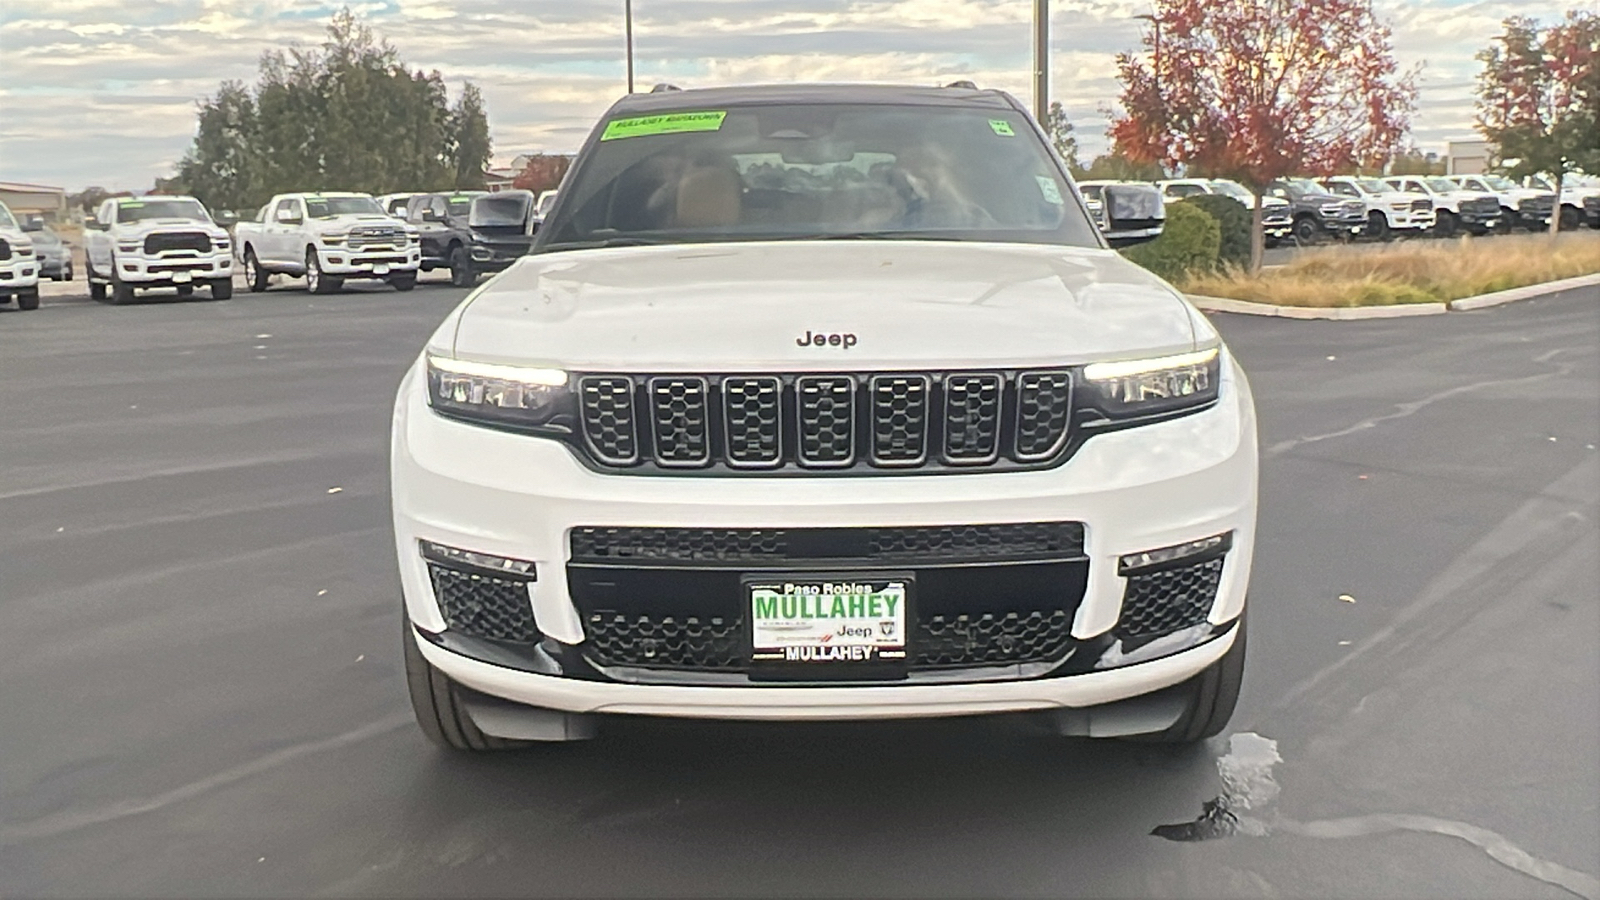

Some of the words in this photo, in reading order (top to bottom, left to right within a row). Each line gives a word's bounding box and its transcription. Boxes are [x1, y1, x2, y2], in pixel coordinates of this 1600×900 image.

[796, 331, 857, 349] Jeep
[784, 583, 820, 595] Paso
[823, 583, 873, 595] Robles
[755, 594, 900, 619] MULLAHEY
[837, 625, 872, 638] Jeep
[785, 646, 873, 661] MULLAHEY
